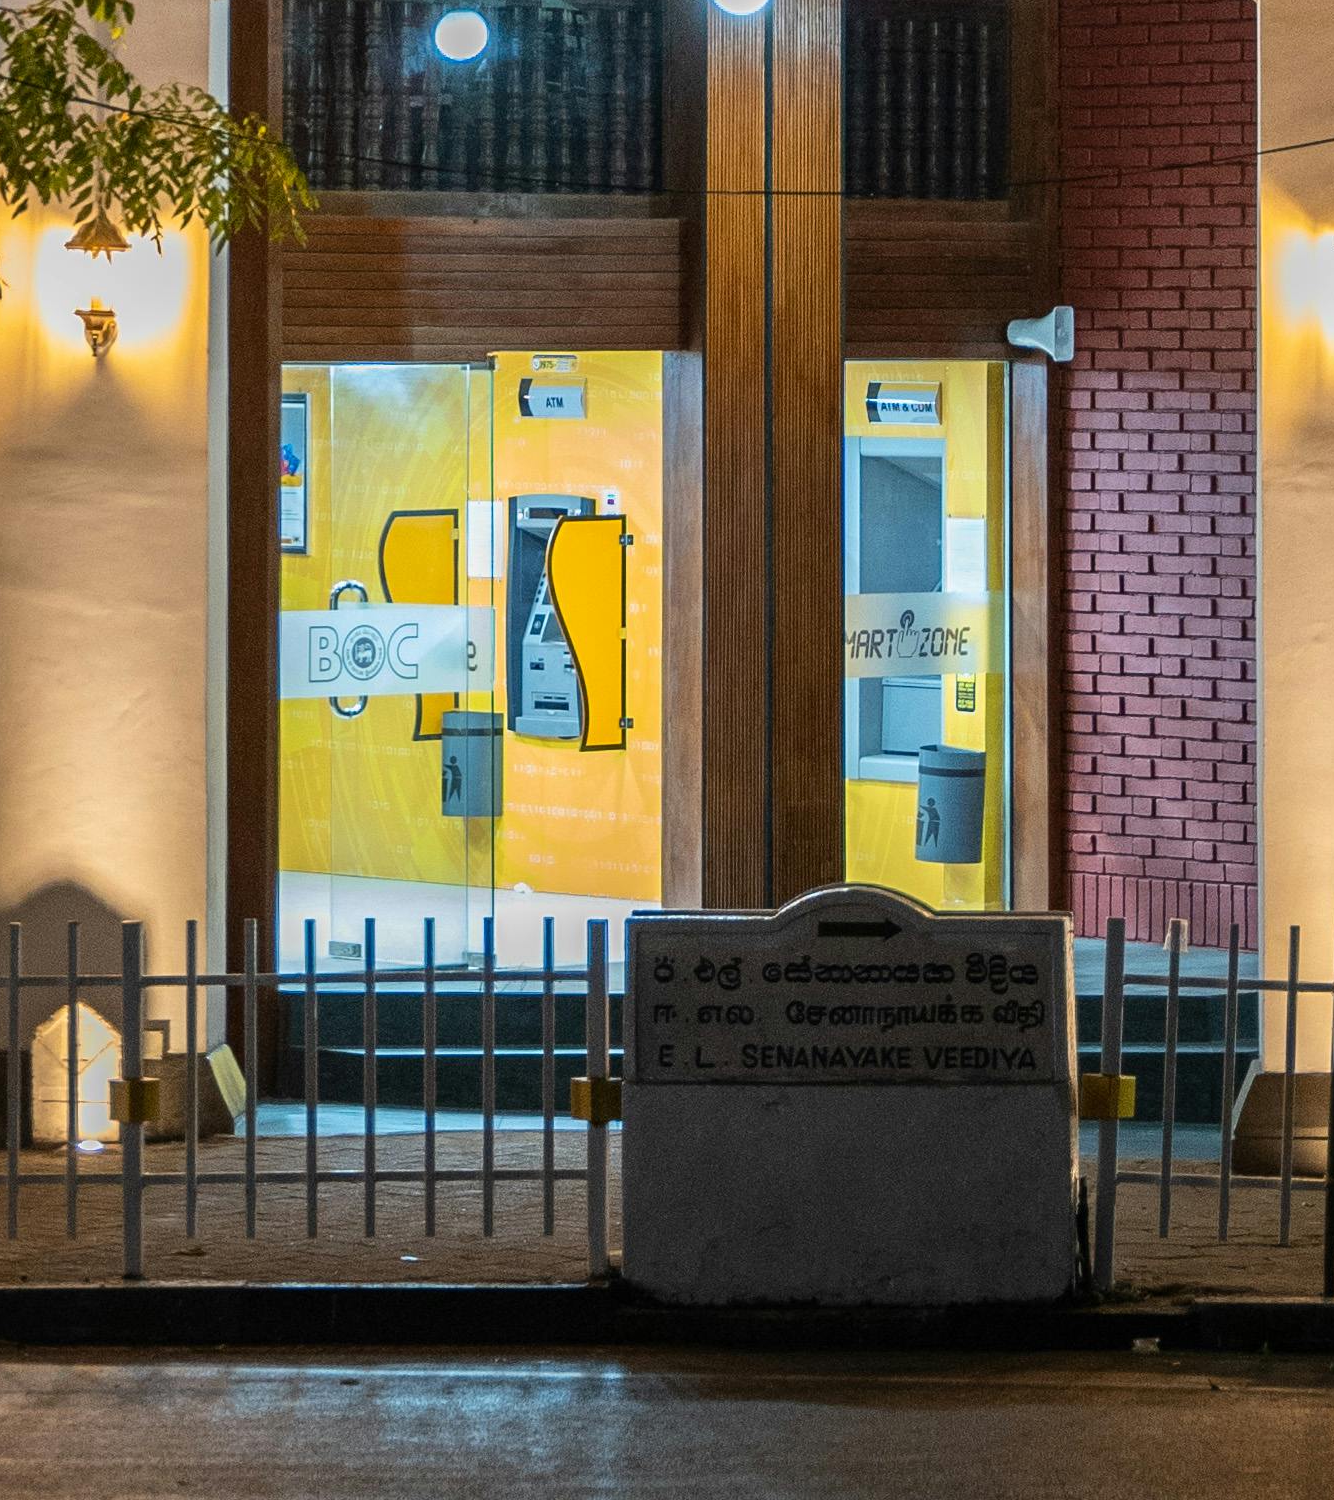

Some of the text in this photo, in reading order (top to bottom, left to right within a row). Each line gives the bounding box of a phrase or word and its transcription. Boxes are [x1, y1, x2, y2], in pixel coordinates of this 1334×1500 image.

[545, 396, 564, 409] ATM
[903, 402, 909, 412] &
[308, 623, 419, 683] BOC
[845, 626, 971, 660] MART ZONE
[742, 1043, 912, 1071] SENANAYAKE
[925, 1044, 1037, 1071] VEEDIYA
